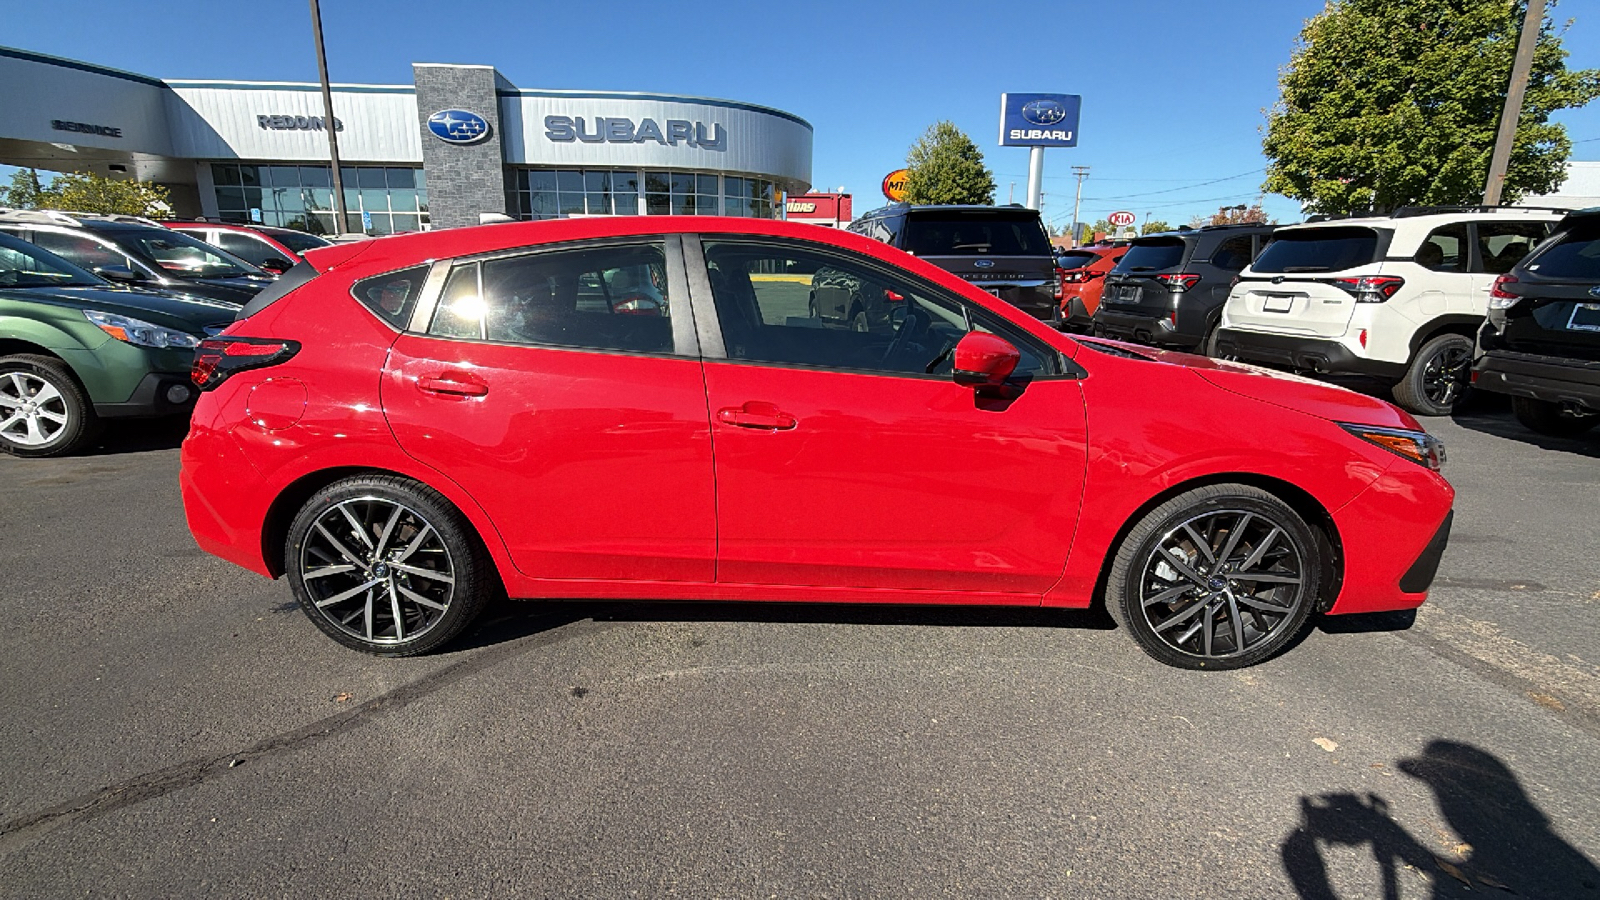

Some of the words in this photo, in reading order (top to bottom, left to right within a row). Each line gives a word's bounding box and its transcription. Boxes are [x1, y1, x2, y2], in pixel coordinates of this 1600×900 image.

[544, 115, 725, 150] SUBARU
[1010, 129, 1073, 141] SUBARU
[1114, 214, 1131, 224] KIA
